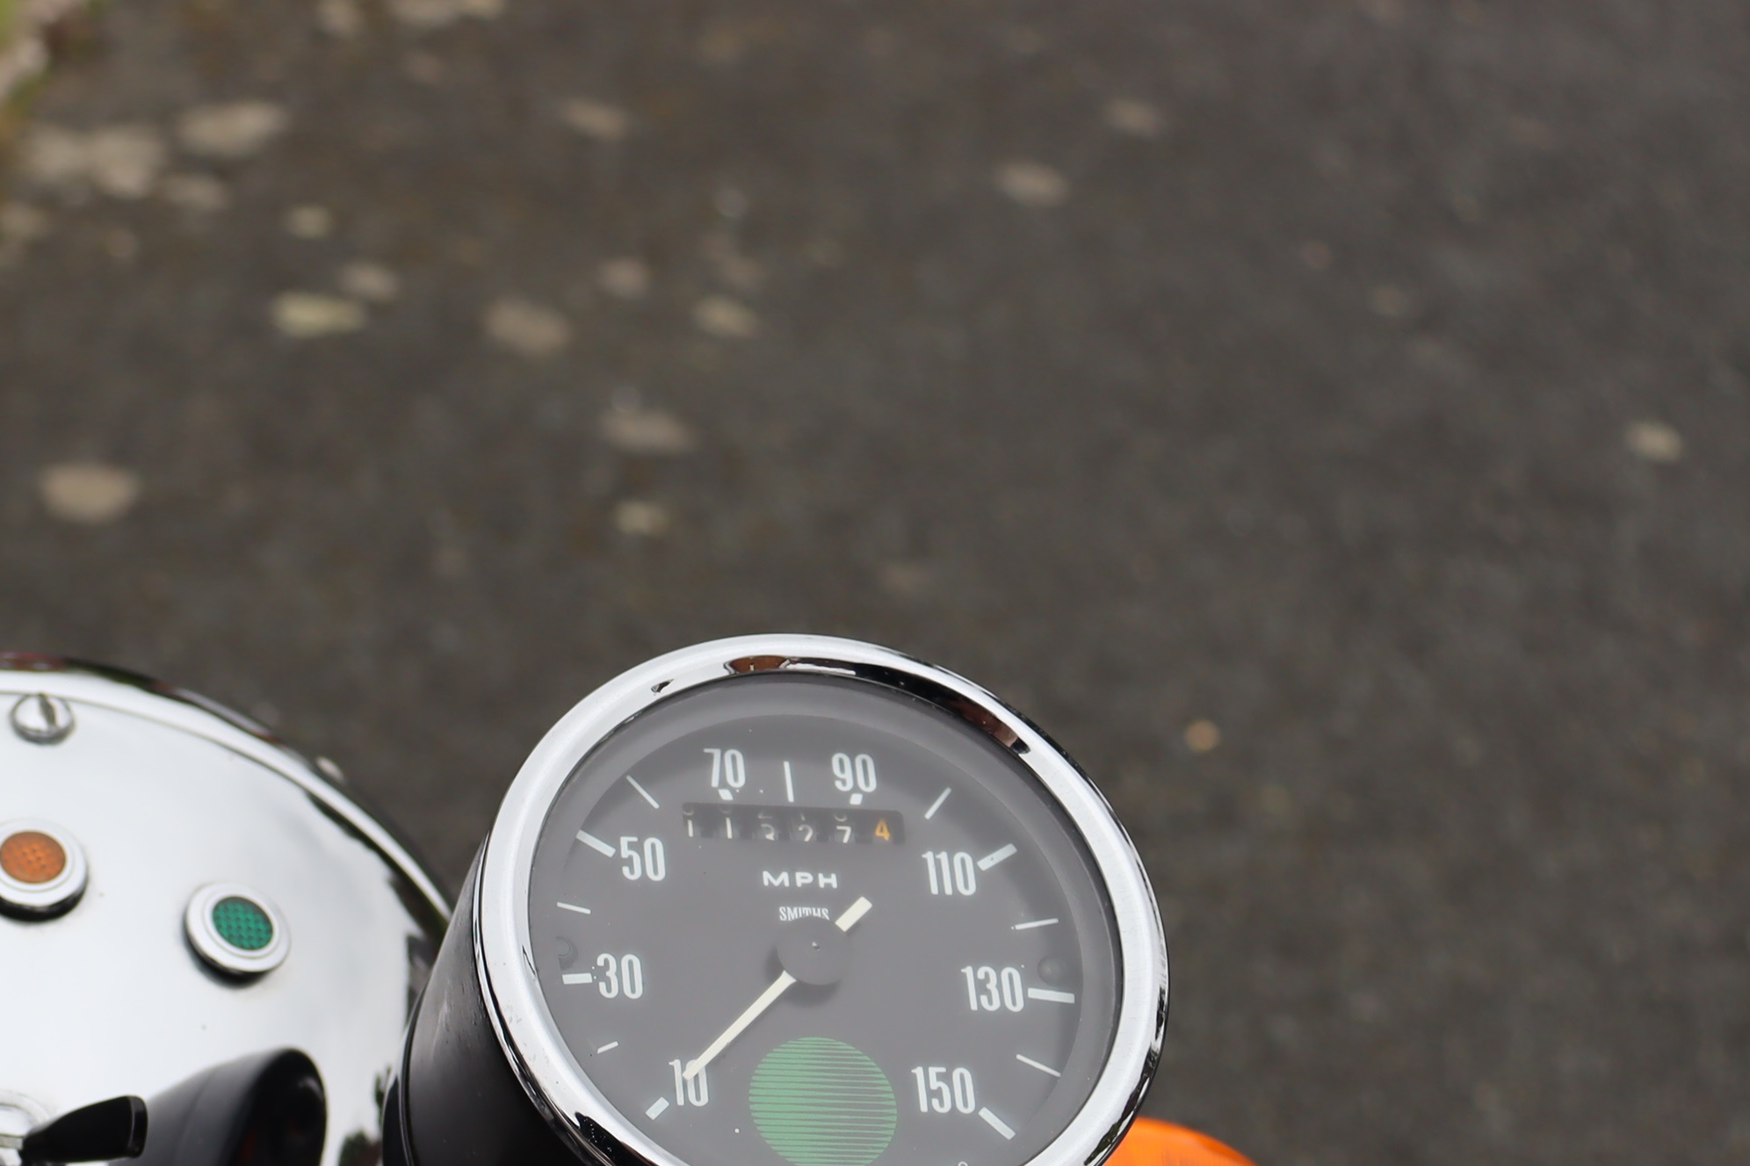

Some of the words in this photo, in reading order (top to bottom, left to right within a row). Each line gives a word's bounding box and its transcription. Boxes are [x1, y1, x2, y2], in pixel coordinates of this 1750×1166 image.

[703, 748, 746, 789] 70
[831, 752, 877, 793] 90
[620, 836, 666, 882] 50
[762, 870, 838, 889] MPH
[921, 850, 977, 896] 110
[778, 905, 831, 921] SMITHS
[596, 953, 644, 1000] 30
[961, 965, 1025, 1013] 130
[668, 1058, 710, 1107] 10
[911, 1066, 976, 1114] 150
